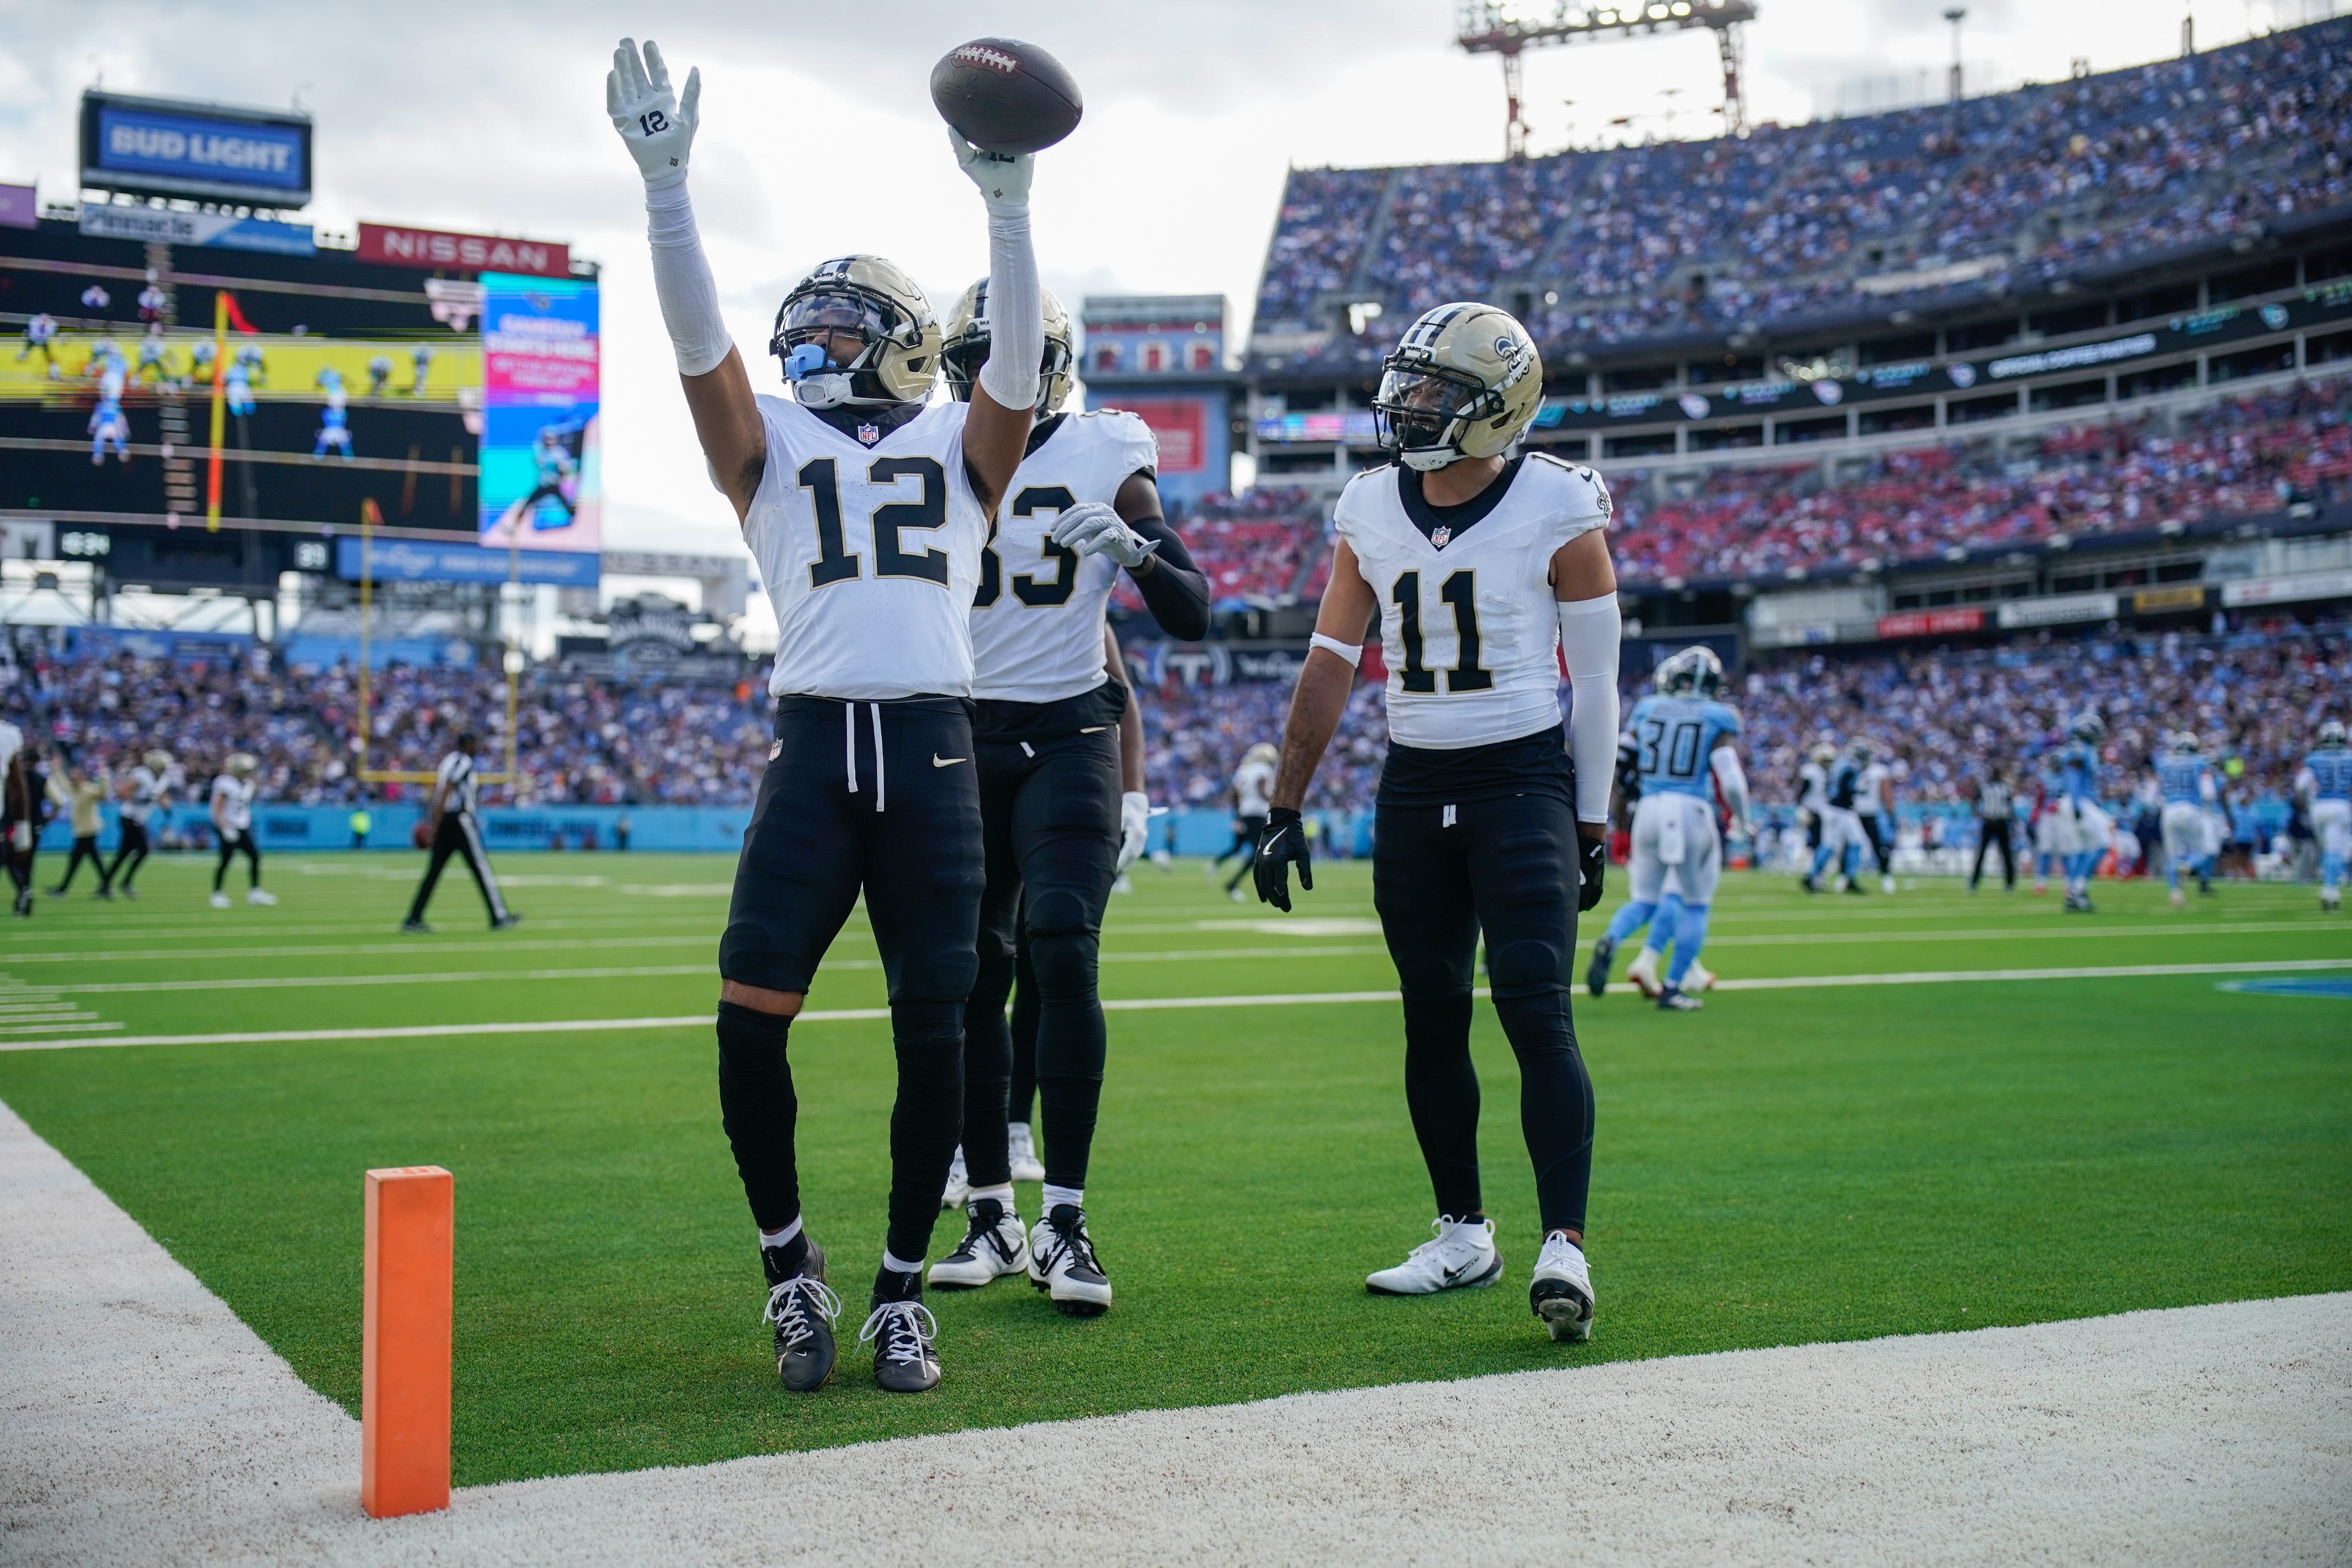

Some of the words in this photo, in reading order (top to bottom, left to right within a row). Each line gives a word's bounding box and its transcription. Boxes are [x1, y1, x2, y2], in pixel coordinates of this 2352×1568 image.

[640, 111, 669, 136] 12
[110, 125, 186, 161] BUD
[189, 133, 289, 172] LIGHT
[384, 230, 548, 271] NISSAN
[862, 432, 876, 440] NFL
[796, 456, 950, 591] 12
[1434, 534, 1446, 543] NFL
[1391, 568, 1495, 695] 11
[1639, 718, 1702, 777] 30
